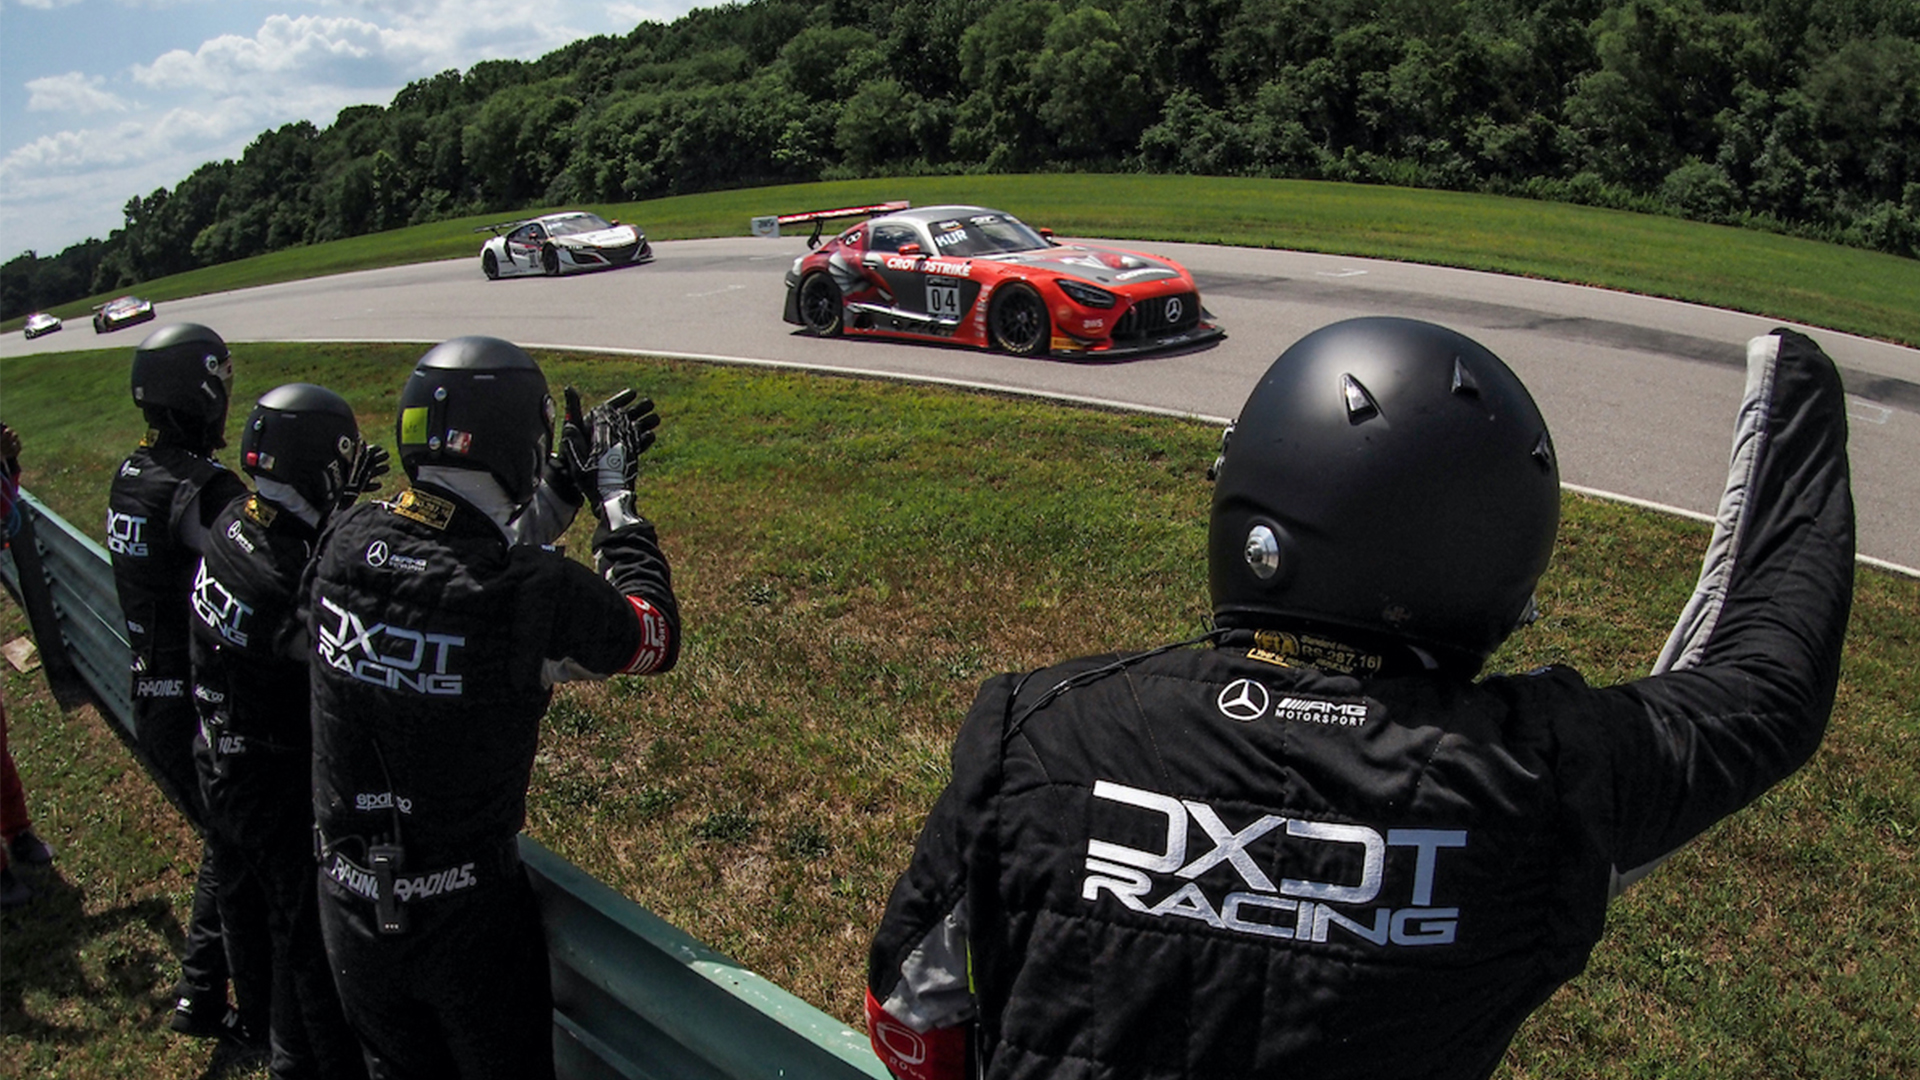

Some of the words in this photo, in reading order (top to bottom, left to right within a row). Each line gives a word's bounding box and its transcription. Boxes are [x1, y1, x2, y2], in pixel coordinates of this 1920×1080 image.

[935, 229, 968, 247] KUR
[887, 258, 972, 277] CROWDSTRIKE
[932, 289, 956, 312] 04
[107, 507, 147, 543] XDT
[192, 591, 248, 647] CING
[319, 596, 466, 674] DXDT
[318, 634, 463, 695] RACING
[1275, 708, 1366, 727] MOTORSPORT
[1087, 779, 1468, 906] DXDT
[393, 862, 475, 902] RADIOS
[1081, 857, 1460, 946] RACING
